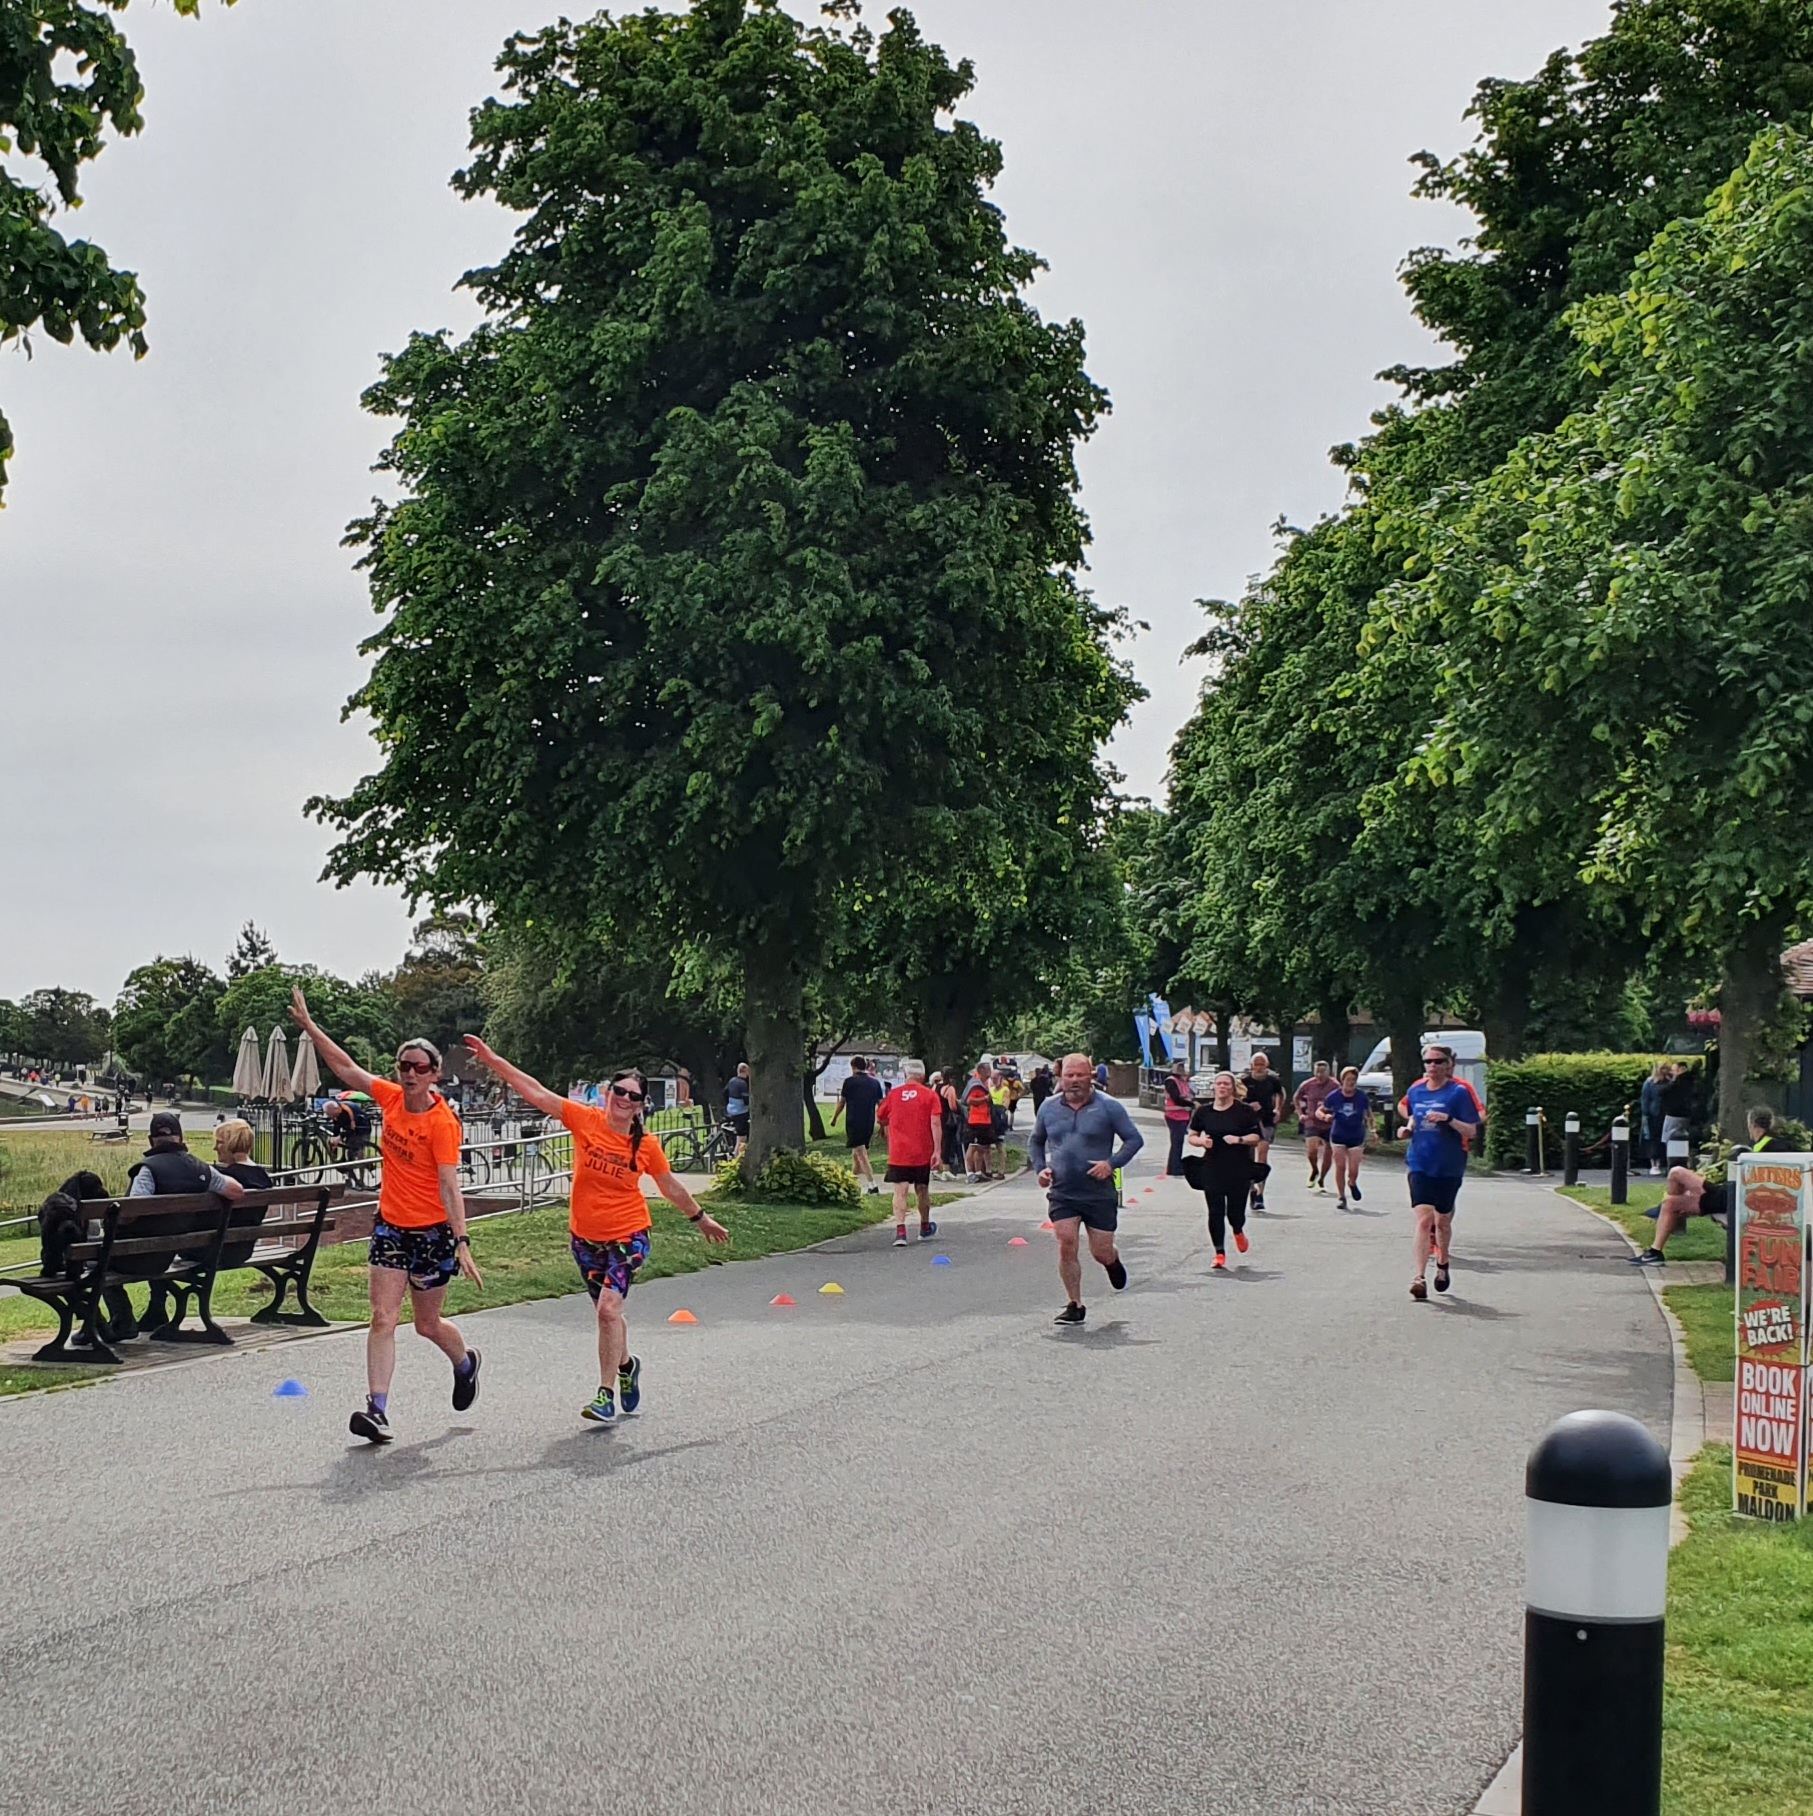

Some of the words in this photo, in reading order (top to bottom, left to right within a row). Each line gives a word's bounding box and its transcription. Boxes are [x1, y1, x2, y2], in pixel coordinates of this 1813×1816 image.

[901, 1089, 917, 1101] 50
[584, 1158, 624, 1179] JULIE
[1741, 1236, 1801, 1268] FUN
[1741, 1263, 1800, 1296] FAIR
[1743, 1305, 1792, 1328] WE'RE
[1747, 1323, 1794, 1347] BACK!
[1742, 1362, 1797, 1397] BOOK
[1741, 1391, 1797, 1422] ONLINE
[1741, 1415, 1795, 1456] NOW
[1738, 1461, 1797, 1487] PROMENADE
[1753, 1480, 1778, 1499] PARK
[1738, 1493, 1796, 1522] MALDON
